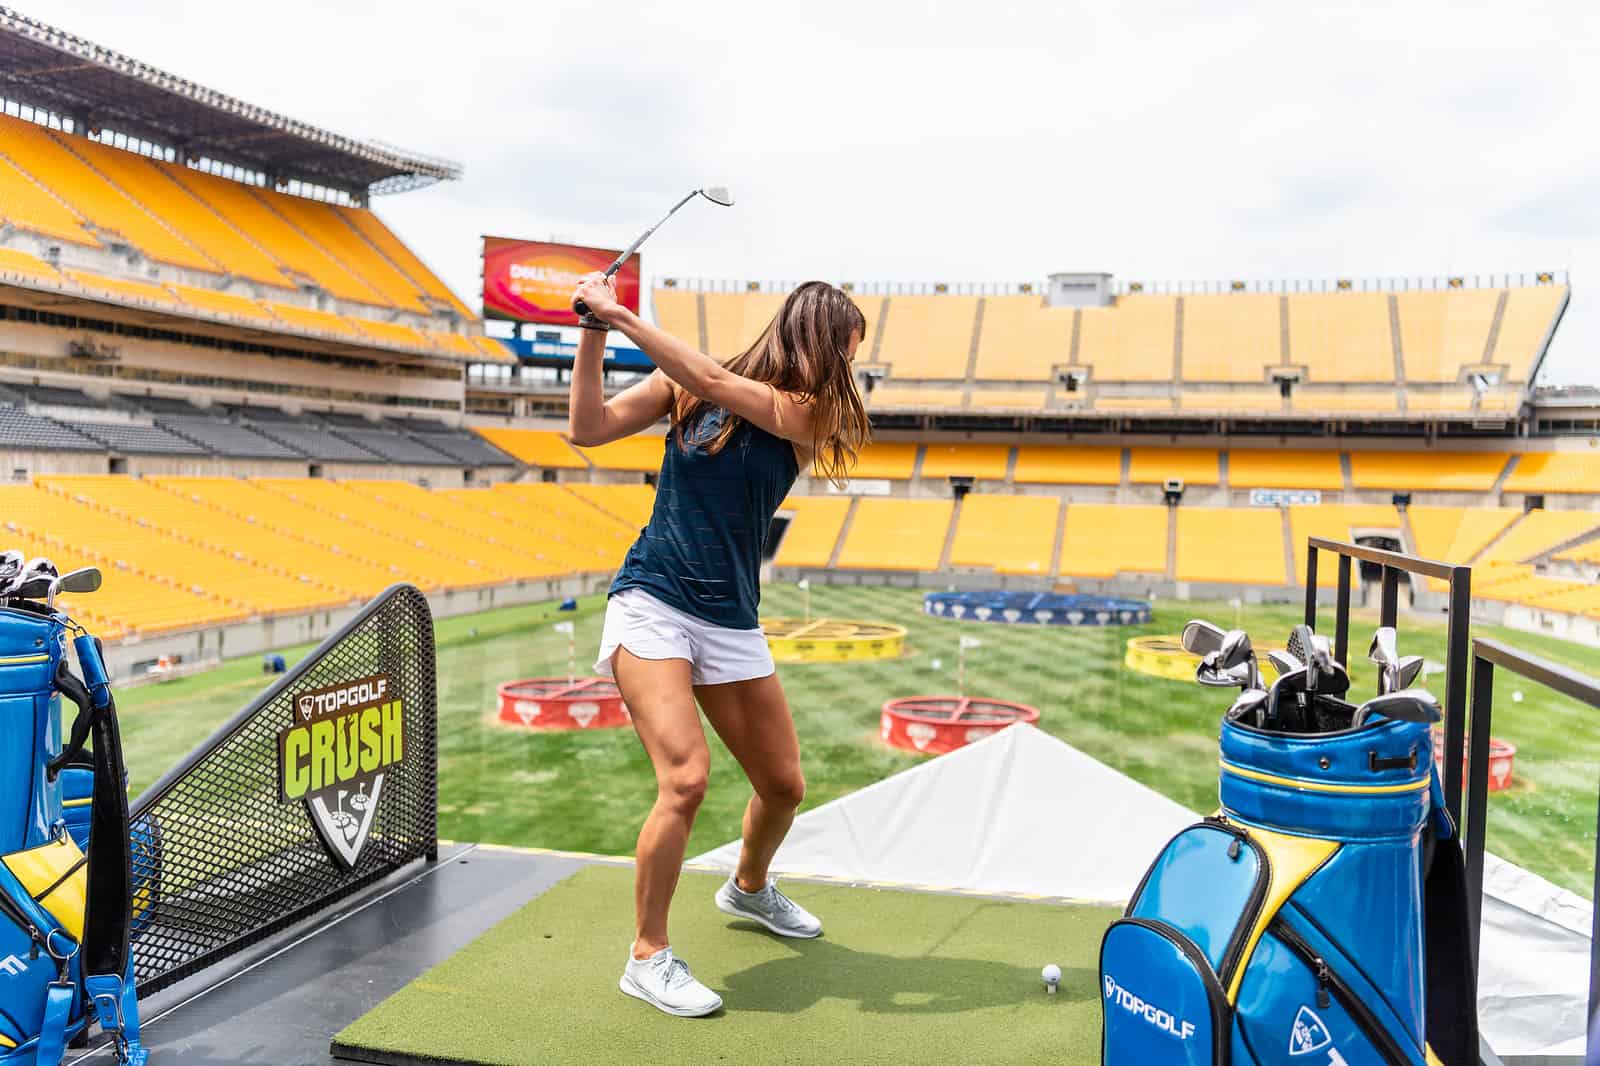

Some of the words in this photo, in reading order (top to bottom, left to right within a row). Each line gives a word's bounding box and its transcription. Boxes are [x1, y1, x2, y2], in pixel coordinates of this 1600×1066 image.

[315, 679, 387, 714] TOPGOLF
[285, 700, 403, 799] CRUSH
[1115, 985, 1195, 1040] TOPGOLF
